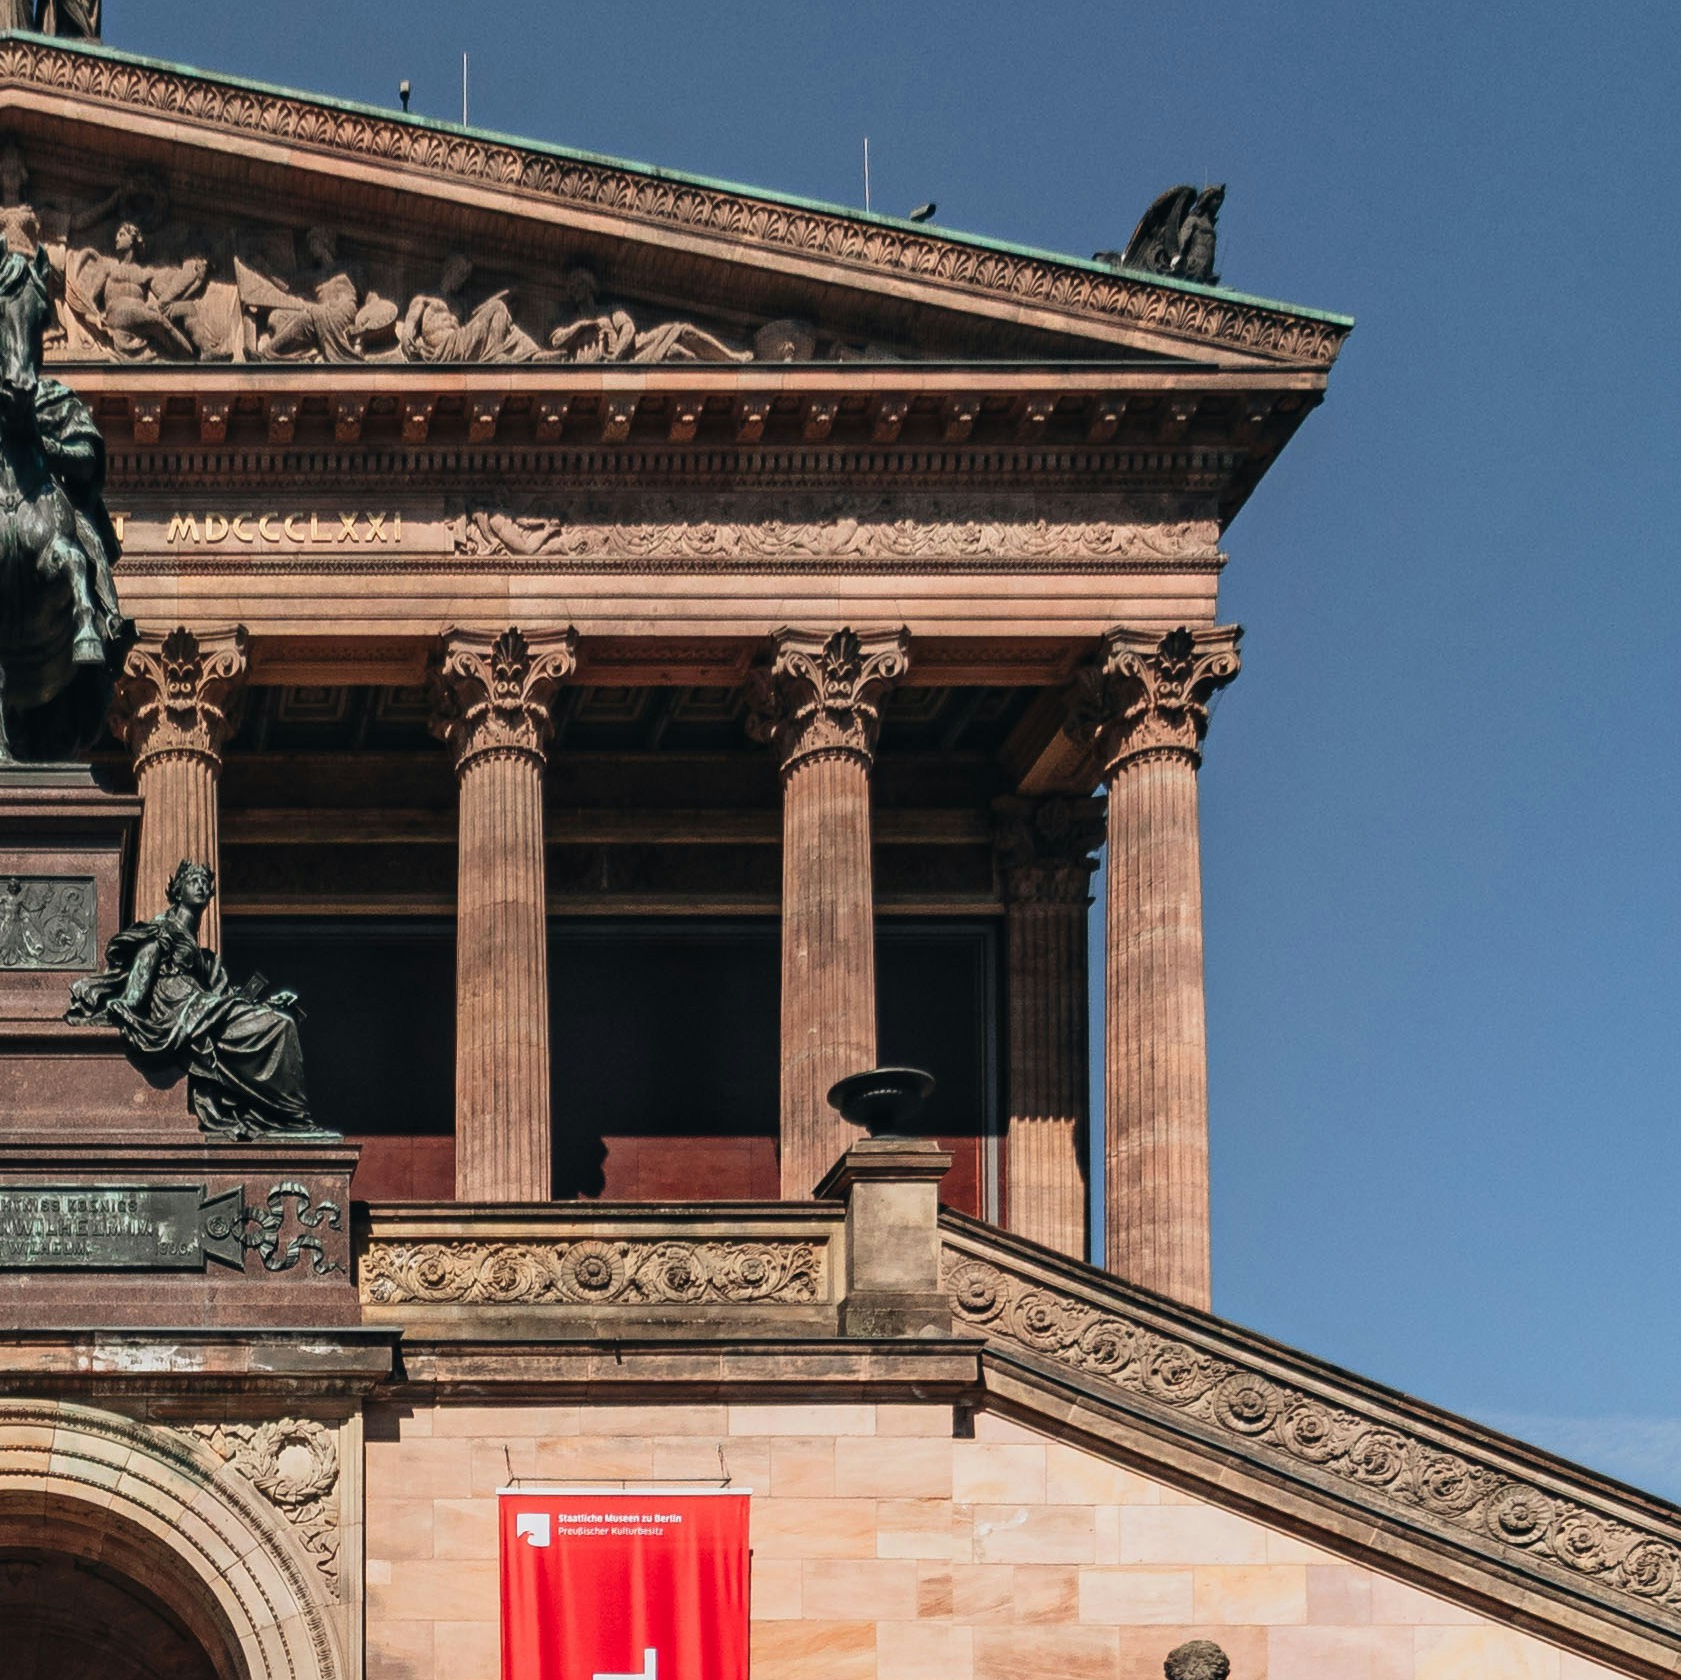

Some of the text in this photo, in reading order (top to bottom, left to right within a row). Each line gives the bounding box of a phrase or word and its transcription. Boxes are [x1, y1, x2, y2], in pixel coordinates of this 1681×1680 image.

[167, 511, 401, 543] MDCCCLXXI
[13, 1219, 123, 1237] WILHELM
[558, 1514, 682, 1523] Staatliche Museen zu Berlin
[558, 1527, 664, 1536] Preußischer Kulturbesitz
